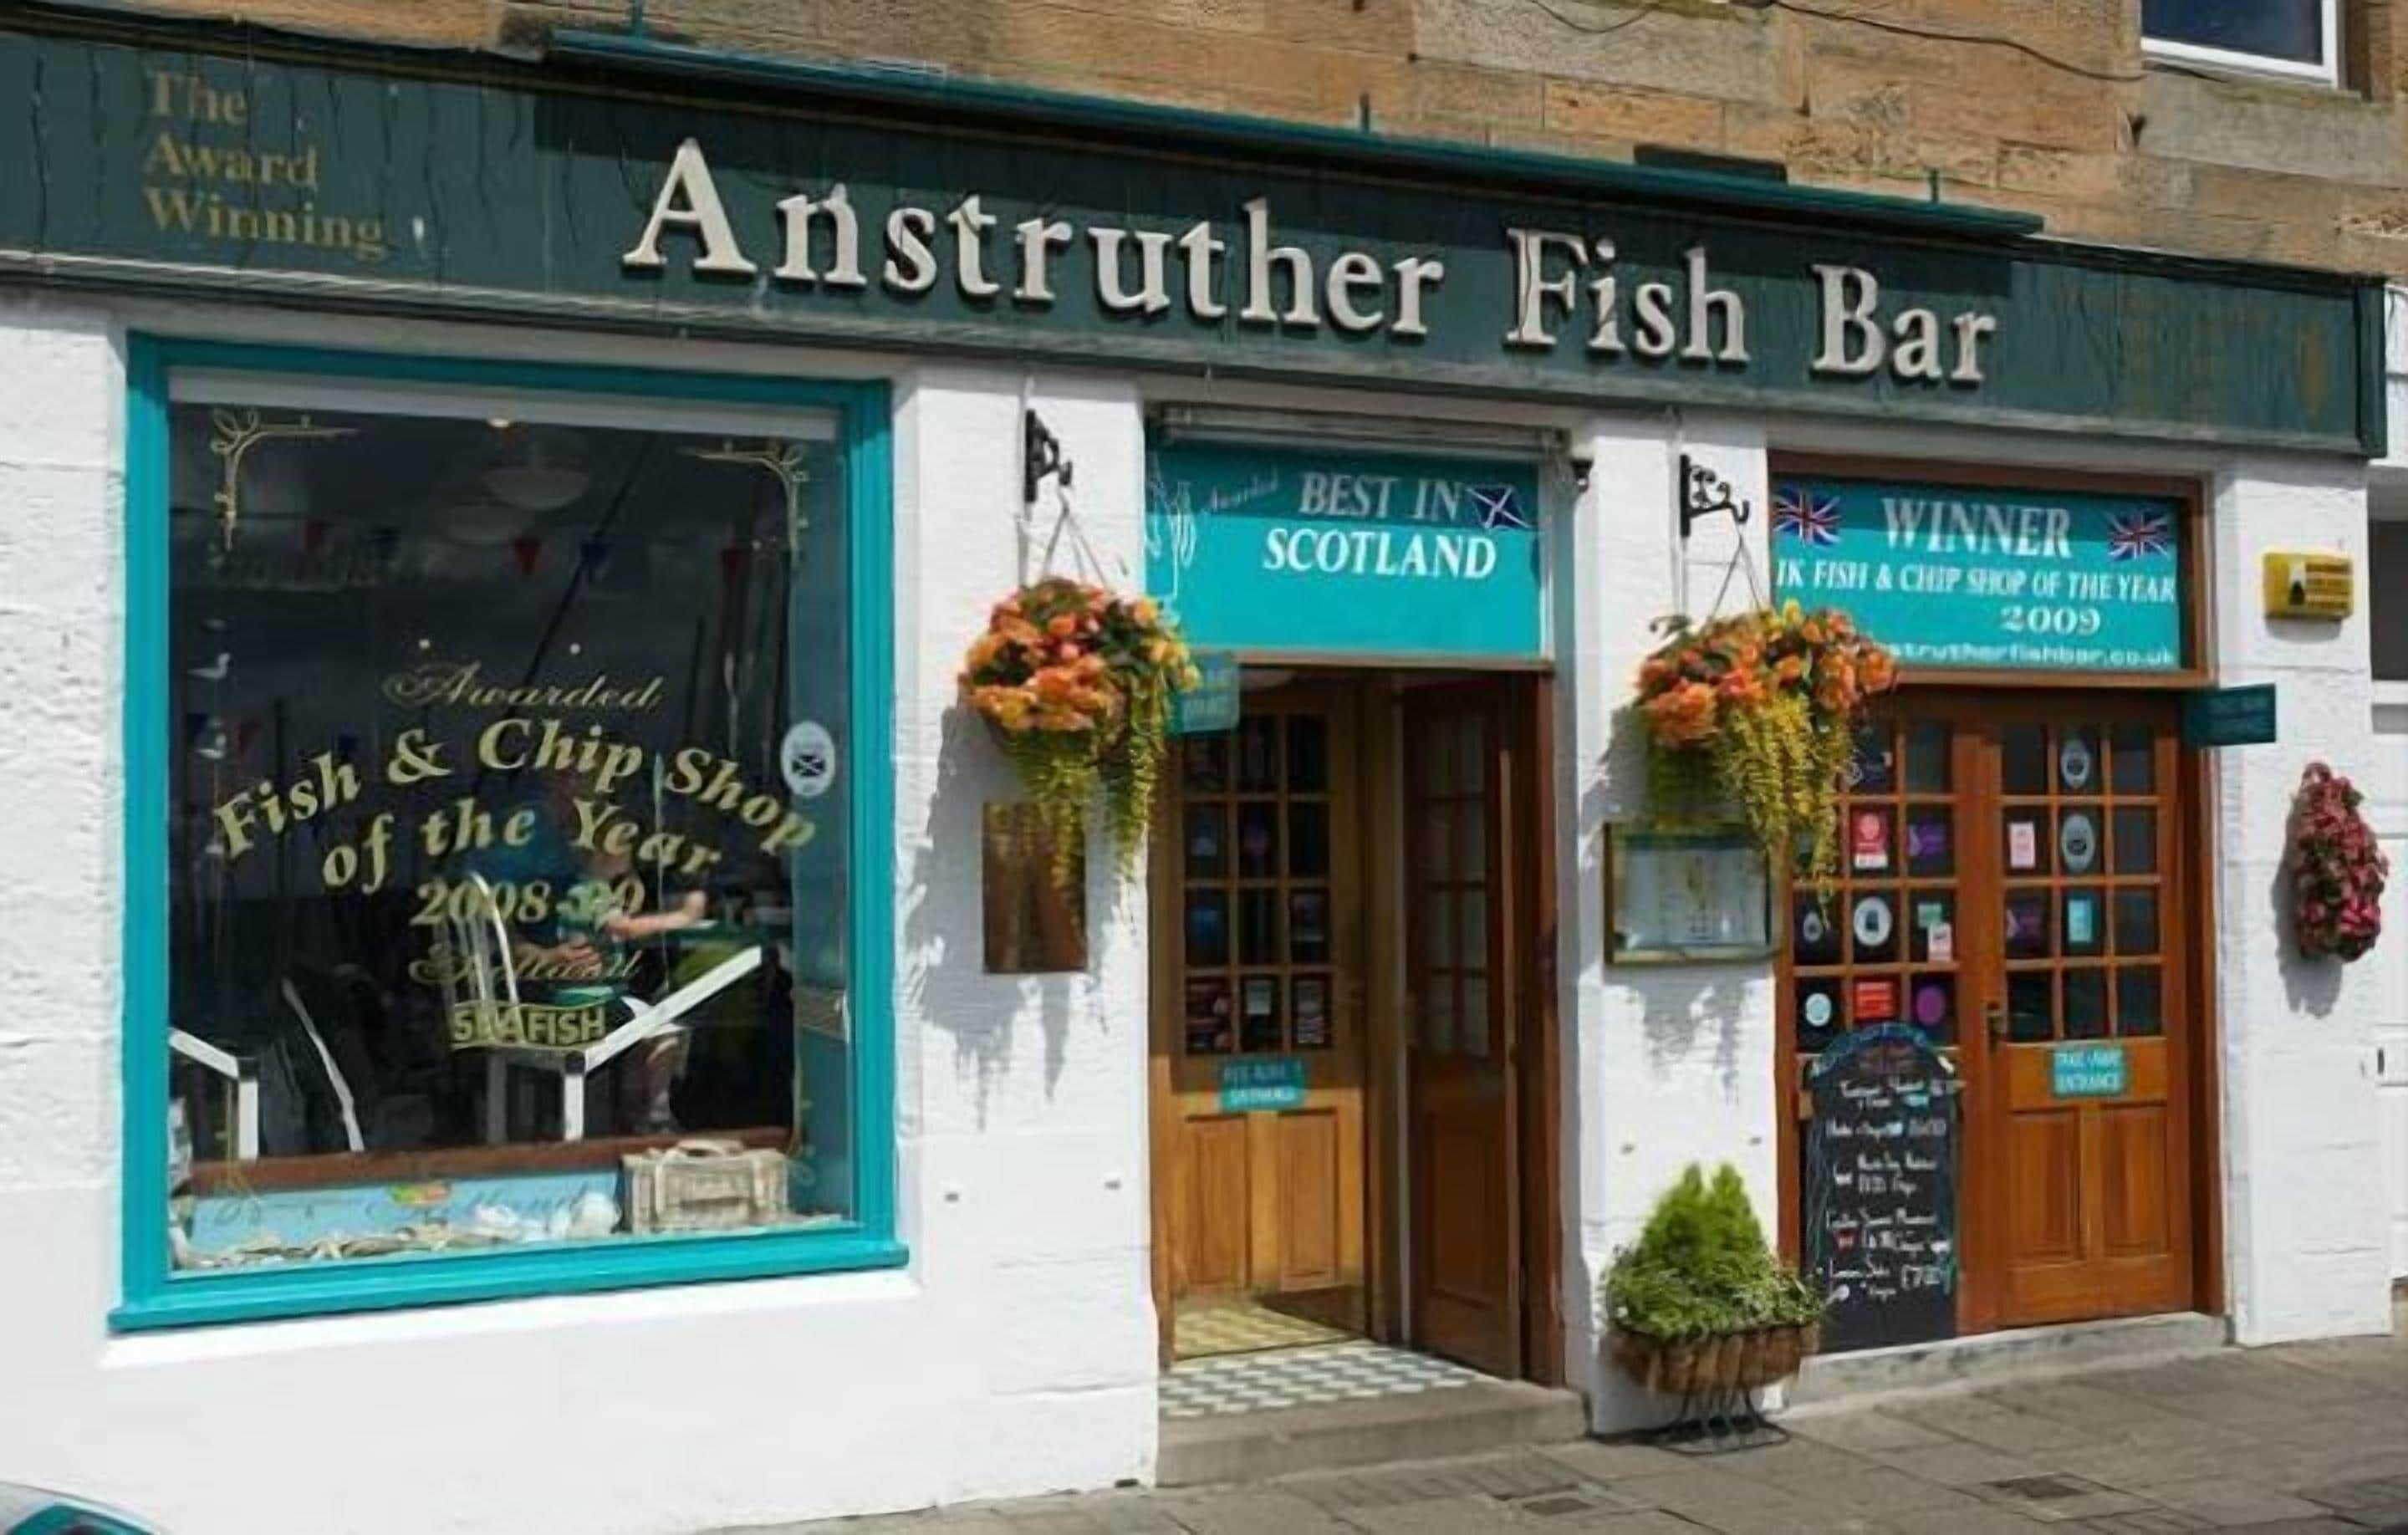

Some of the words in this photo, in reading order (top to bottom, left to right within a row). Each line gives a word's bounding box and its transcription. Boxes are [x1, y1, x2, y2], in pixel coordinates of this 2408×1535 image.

[145, 70, 248, 125] The
[145, 131, 320, 190] Award
[143, 186, 387, 262] Winning
[621, 135, 1445, 336] Anstruther
[1506, 227, 1752, 365] Fish
[1810, 263, 1997, 385] Bar
[1298, 471, 1398, 519] BEST
[1410, 477, 1464, 522] IN
[1263, 527, 1497, 580] SCOTLAND
[1881, 497, 2072, 559] WINNER
[1814, 559, 1869, 589] FISH
[1900, 564, 1962, 594] CHIP
[1967, 568, 2027, 596] SHOP
[2032, 569, 2061, 599] OF
[2068, 571, 2112, 601] THE
[2117, 574, 2176, 603] YEAR
[2000, 604, 2101, 636] 2009
[381, 660, 663, 709] Awarded
[214, 752, 361, 860] Fish
[387, 728, 454, 784] &
[478, 717, 643, 793] Chip
[666, 747, 816, 856] Shop
[323, 812, 395, 895] of
[420, 797, 536, 857] the
[570, 798, 722, 875] Year
